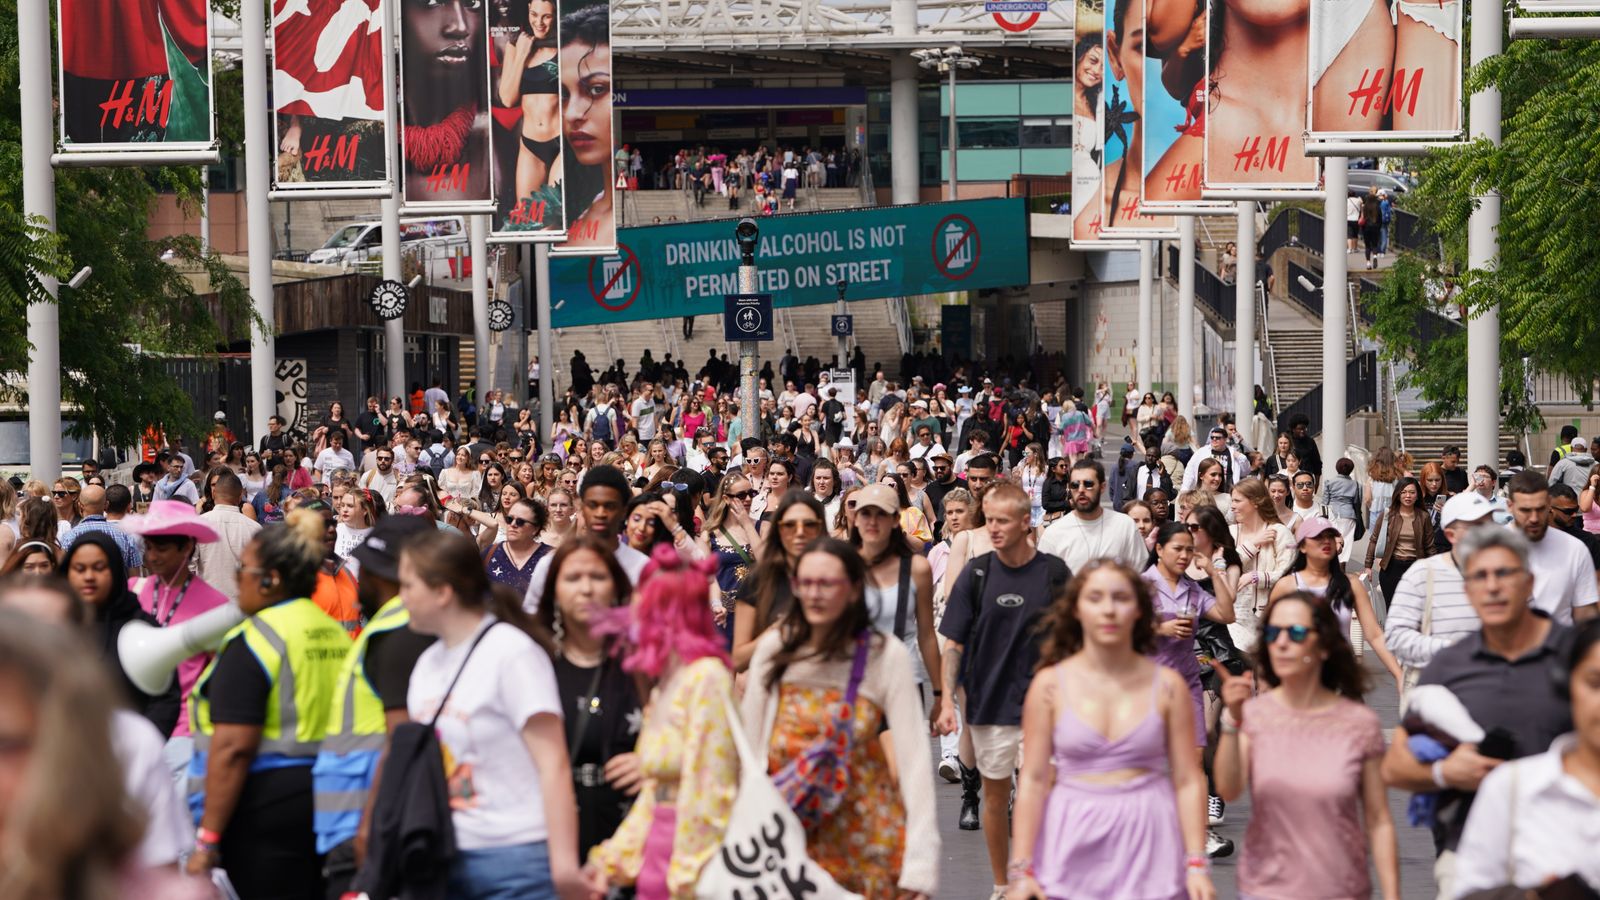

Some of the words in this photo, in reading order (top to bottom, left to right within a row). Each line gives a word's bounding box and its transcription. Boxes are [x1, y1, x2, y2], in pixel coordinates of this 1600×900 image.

[986, 3, 1046, 11] UNDERGROUND
[99, 79, 174, 129] H&M
[1348, 67, 1424, 117] H&M
[304, 133, 360, 172] H&M
[1233, 135, 1291, 173] H&M
[425, 162, 470, 193] H&M
[509, 199, 546, 225] H&M
[665, 239, 742, 266] DRINKIN
[758, 229, 844, 258] ALCOHOL
[848, 227, 866, 251] IS
[870, 224, 907, 248] NOT
[372, 284, 386, 304] BLACK
[386, 282, 406, 300] SHEEP
[685, 267, 790, 298] PERMTED
[795, 264, 821, 289] ON
[825, 258, 892, 285] STREET
[379, 303, 406, 318] COFFEE
[304, 647, 349, 661] STEWAR
